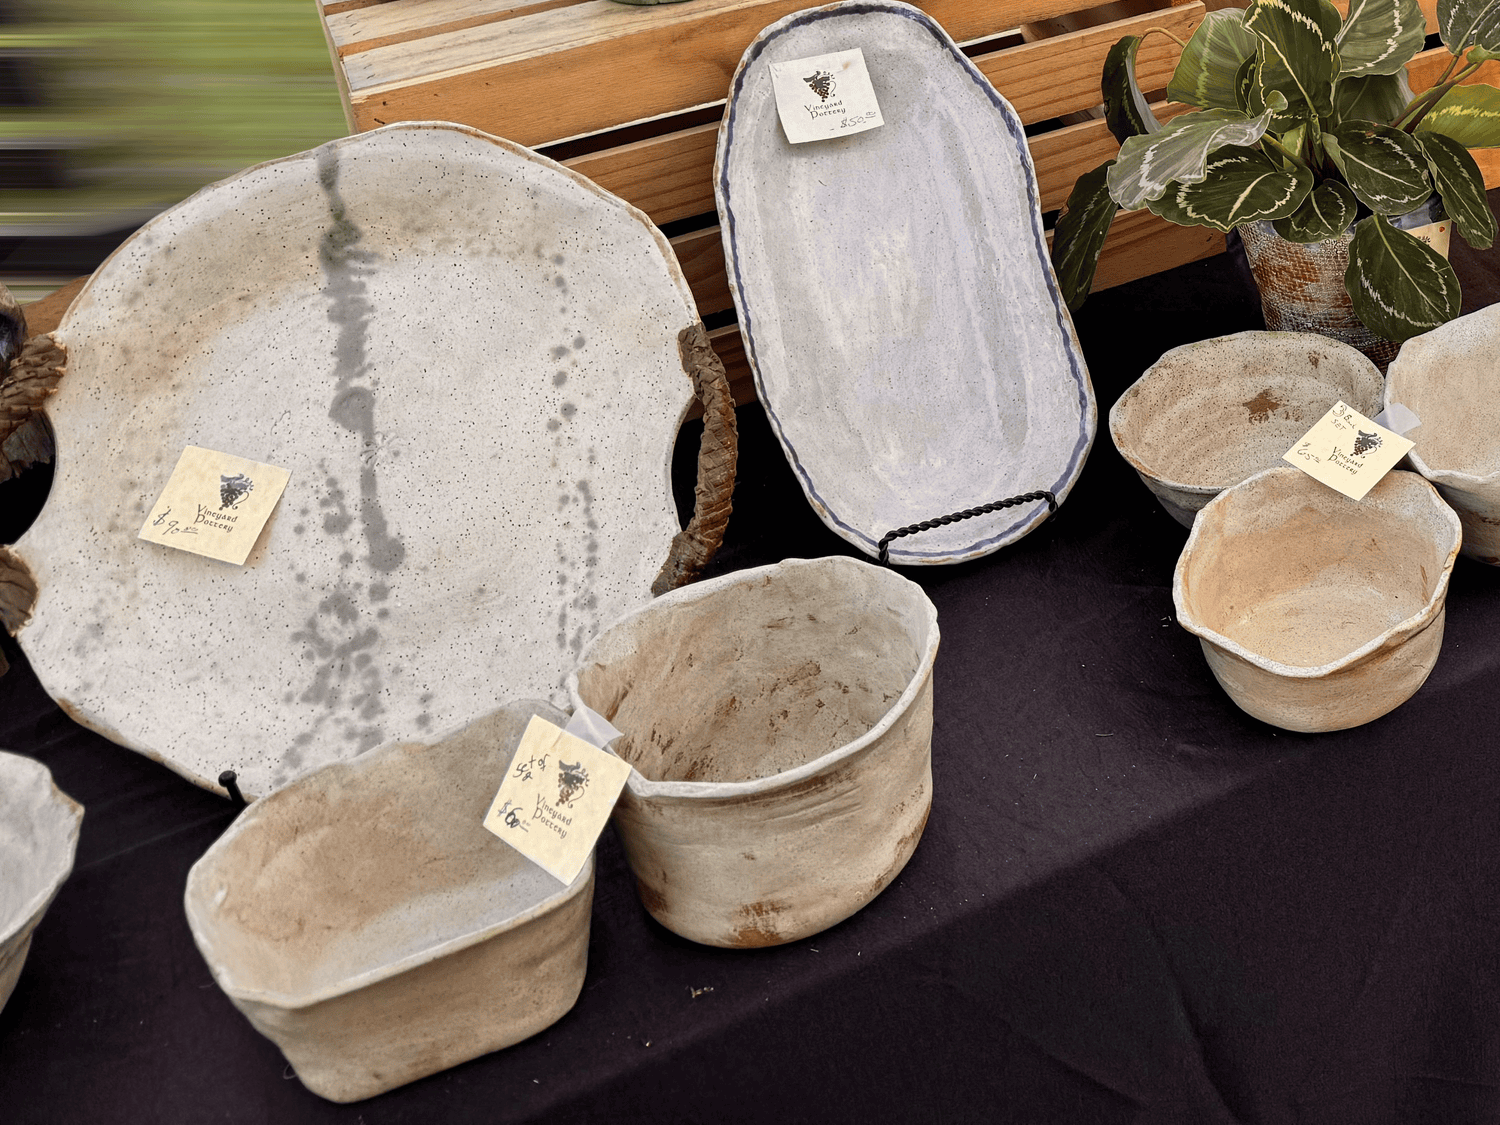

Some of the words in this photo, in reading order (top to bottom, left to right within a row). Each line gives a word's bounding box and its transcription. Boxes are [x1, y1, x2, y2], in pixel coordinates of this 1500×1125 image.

[804, 100, 843, 113] Vineyard
[810, 108, 846, 120] Pottery
[1326, 453, 1358, 476] Pottery
[1332, 446, 1364, 469] Vineyard
[193, 514, 234, 533] Pottery
[198, 504, 238, 523] Vineyard
[536, 793, 573, 826] Vineyard
[532, 806, 568, 839] Pottery
